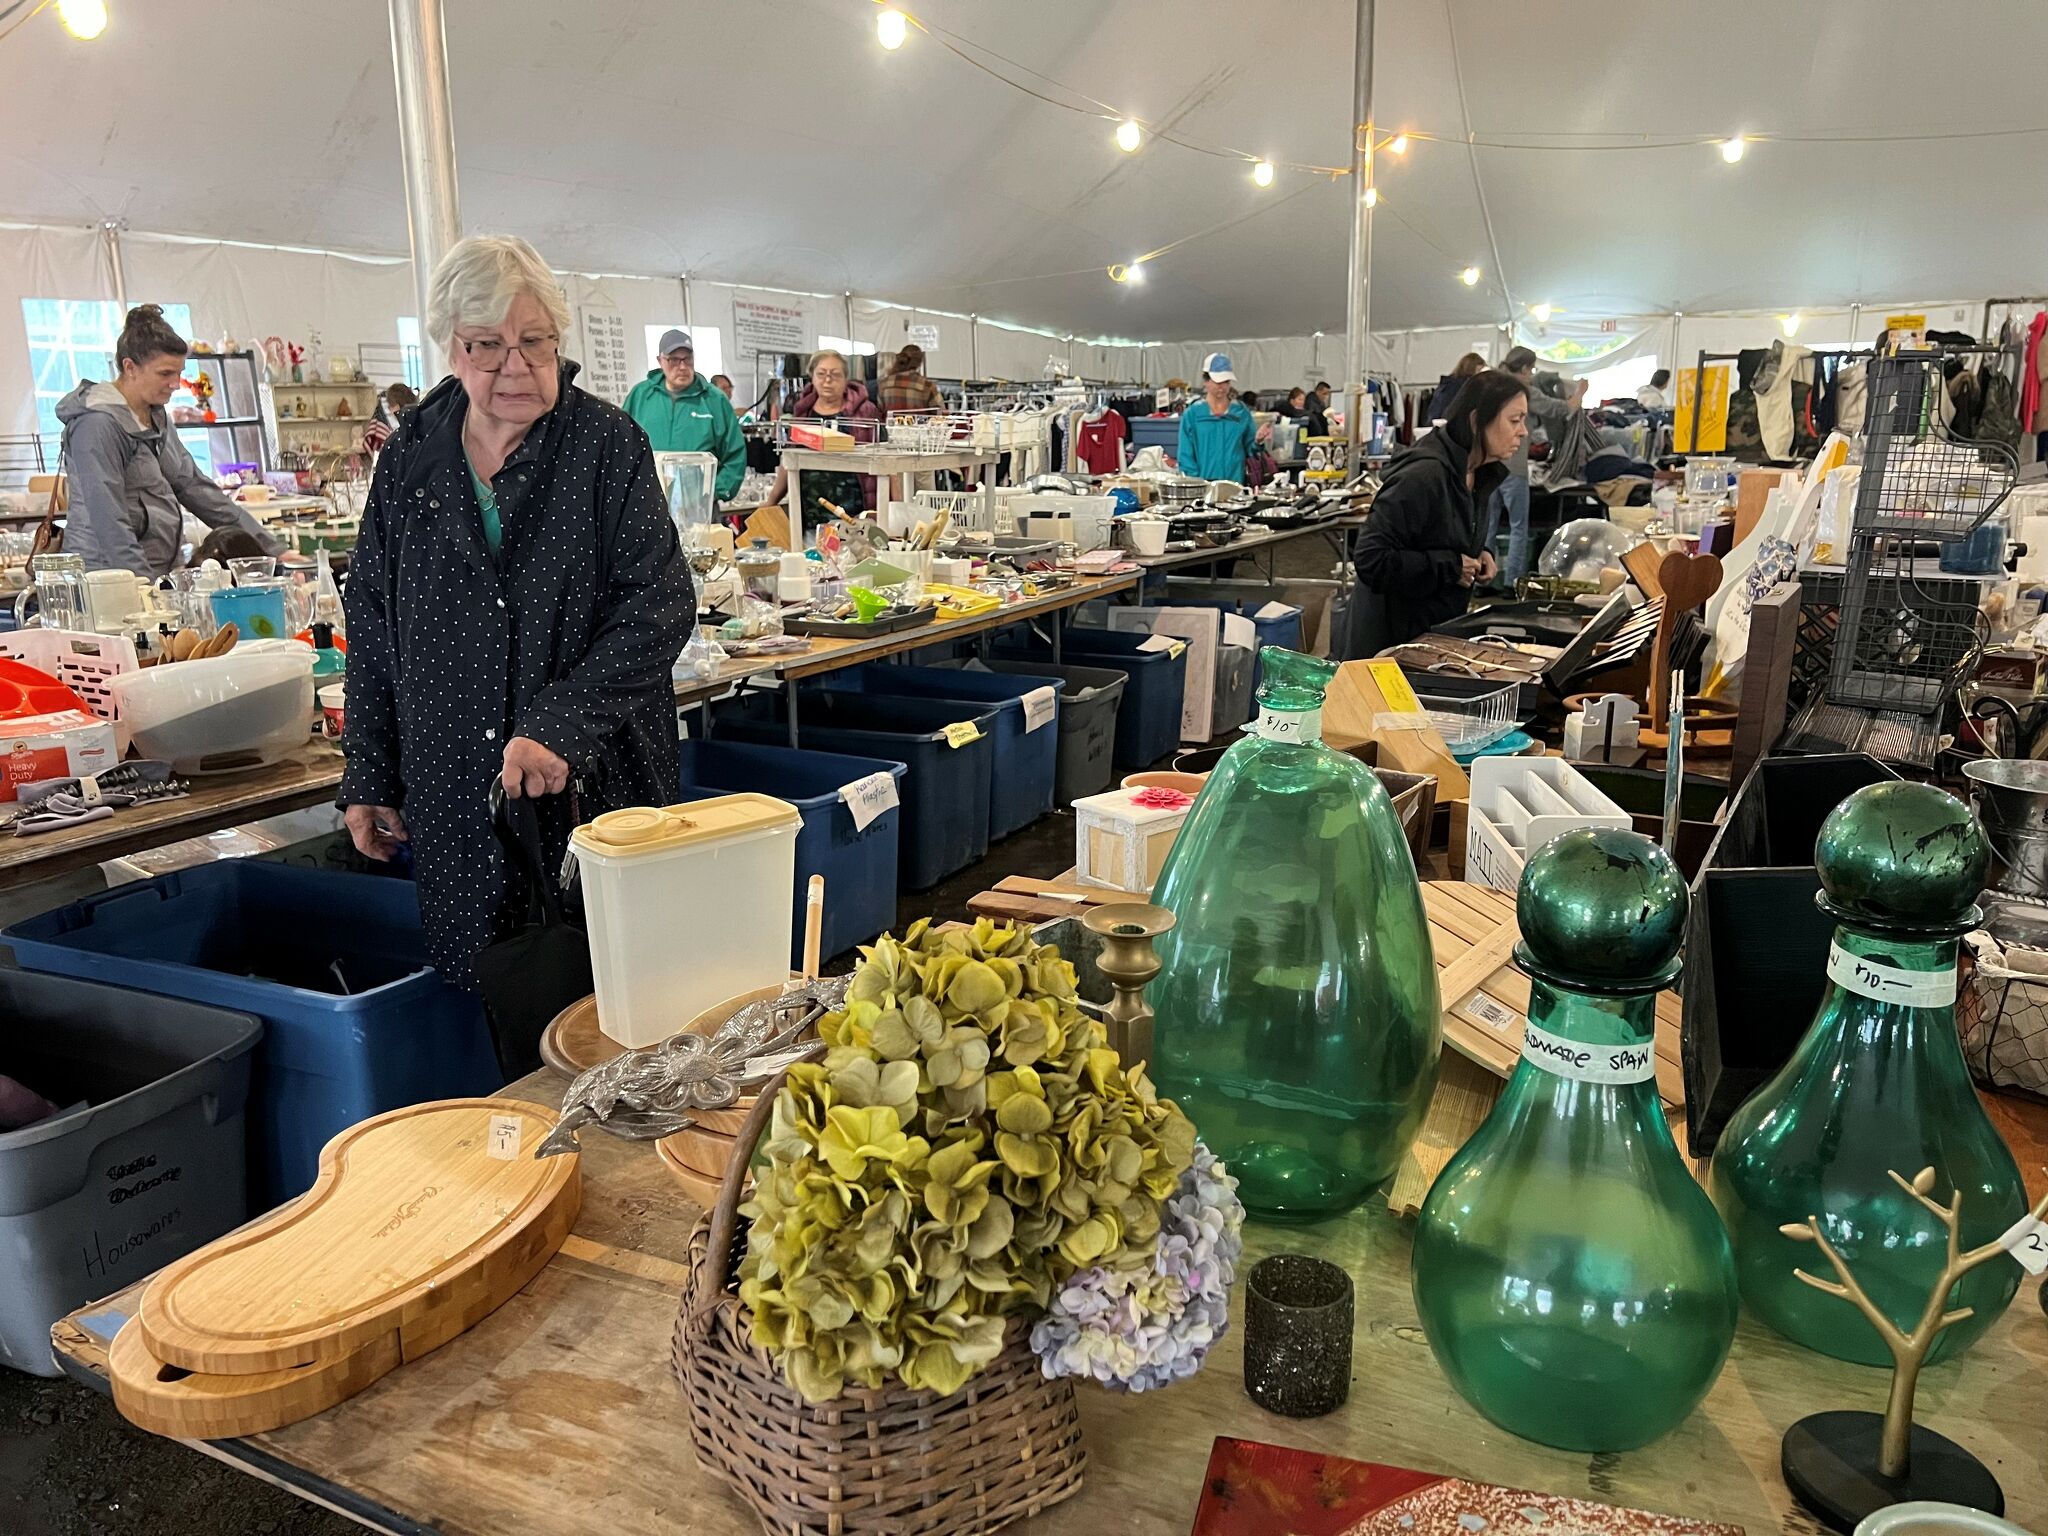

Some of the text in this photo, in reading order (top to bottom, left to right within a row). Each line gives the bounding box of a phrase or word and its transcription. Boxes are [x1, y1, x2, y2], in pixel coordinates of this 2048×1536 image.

[1601, 320, 1616, 332] EXIT
[590, 371, 609, 382] Scarves
[8, 762, 37, 773] Heavy
[10, 771, 33, 781] Duty
[1469, 825, 1494, 887] MAIL
[83, 1207, 181, 1279] Housewares
